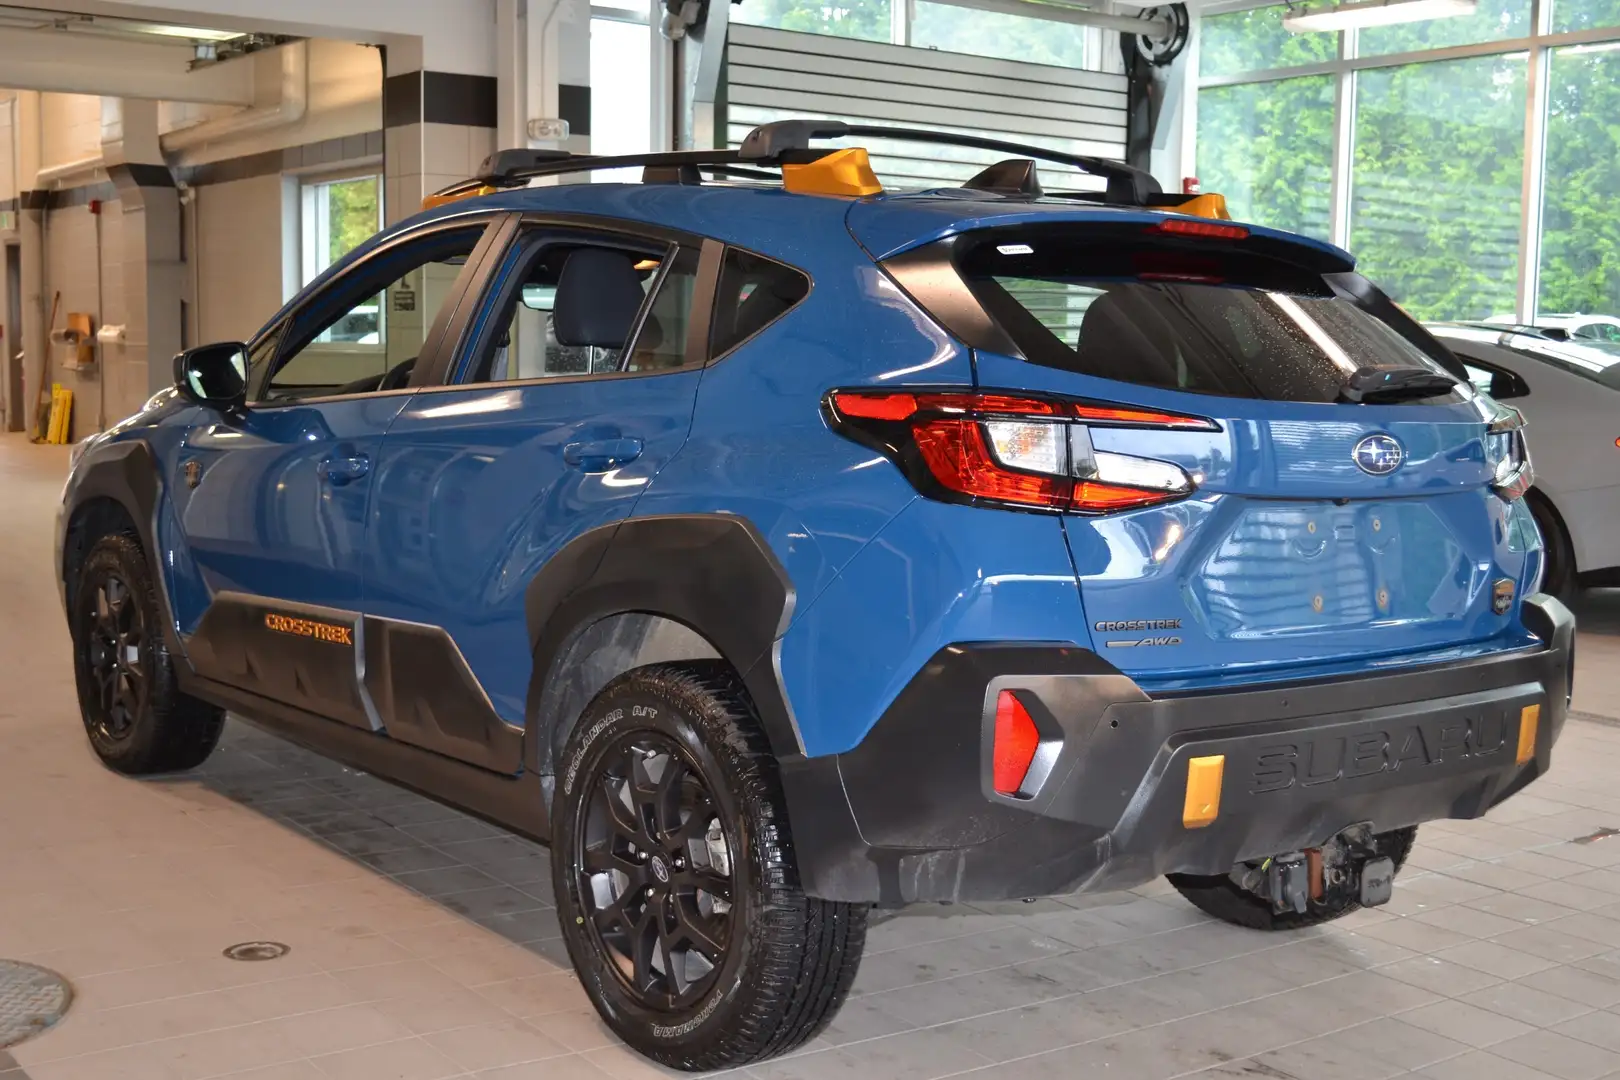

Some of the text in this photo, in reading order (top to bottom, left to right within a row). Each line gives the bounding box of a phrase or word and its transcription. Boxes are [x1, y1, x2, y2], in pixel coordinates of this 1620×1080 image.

[264, 612, 352, 645] CROSSTREK
[1094, 619, 1182, 632] CROSSTREK
[1138, 636, 1183, 647] AWD
[565, 705, 658, 794] GEOLANDAR A/T
[1249, 711, 1508, 795] SUBARU
[652, 988, 724, 1038] YOKOHAMA
